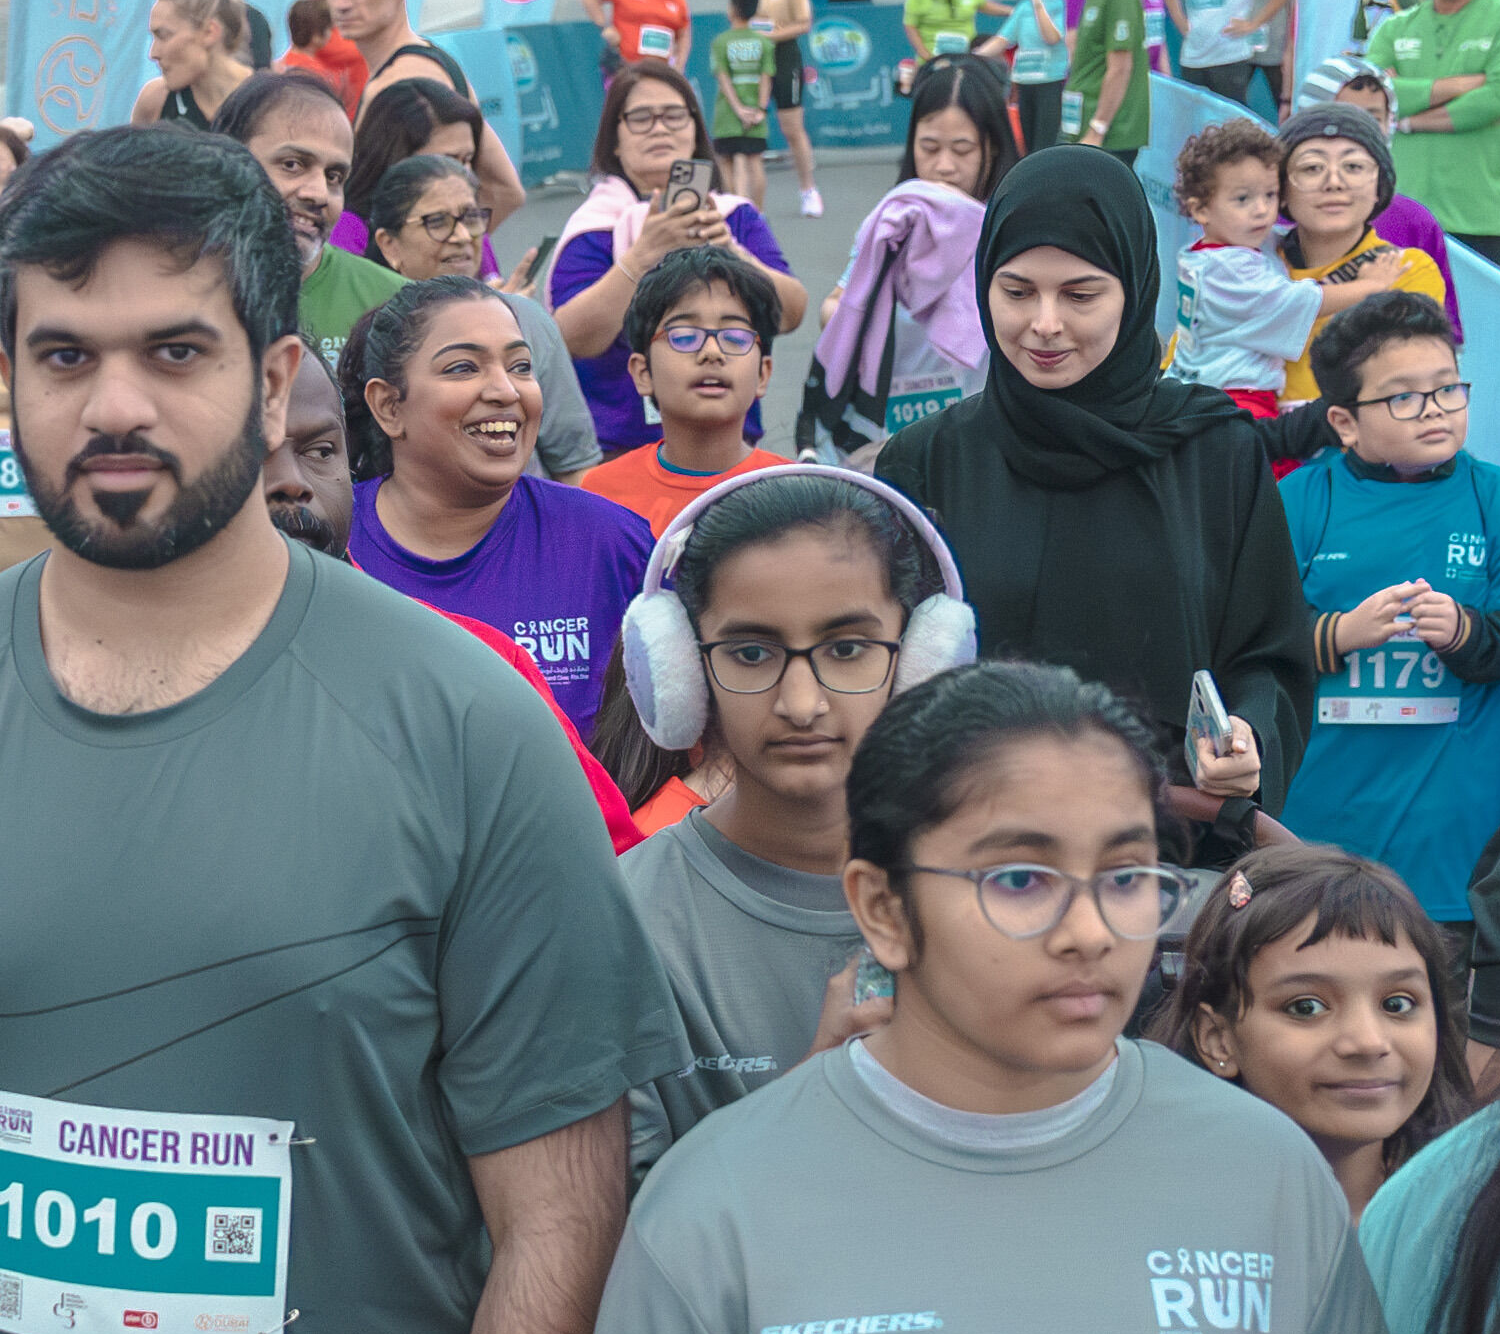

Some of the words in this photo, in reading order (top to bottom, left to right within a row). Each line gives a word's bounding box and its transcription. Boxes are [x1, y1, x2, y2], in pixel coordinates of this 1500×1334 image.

[514, 617, 589, 636] CANCER
[1344, 651, 1446, 690] 1179
[58, 1120, 180, 1165] CANCER
[190, 1132, 255, 1166] RUN
[1146, 1248, 1274, 1279] CANCER
[1150, 1277, 1272, 1333] RUN
